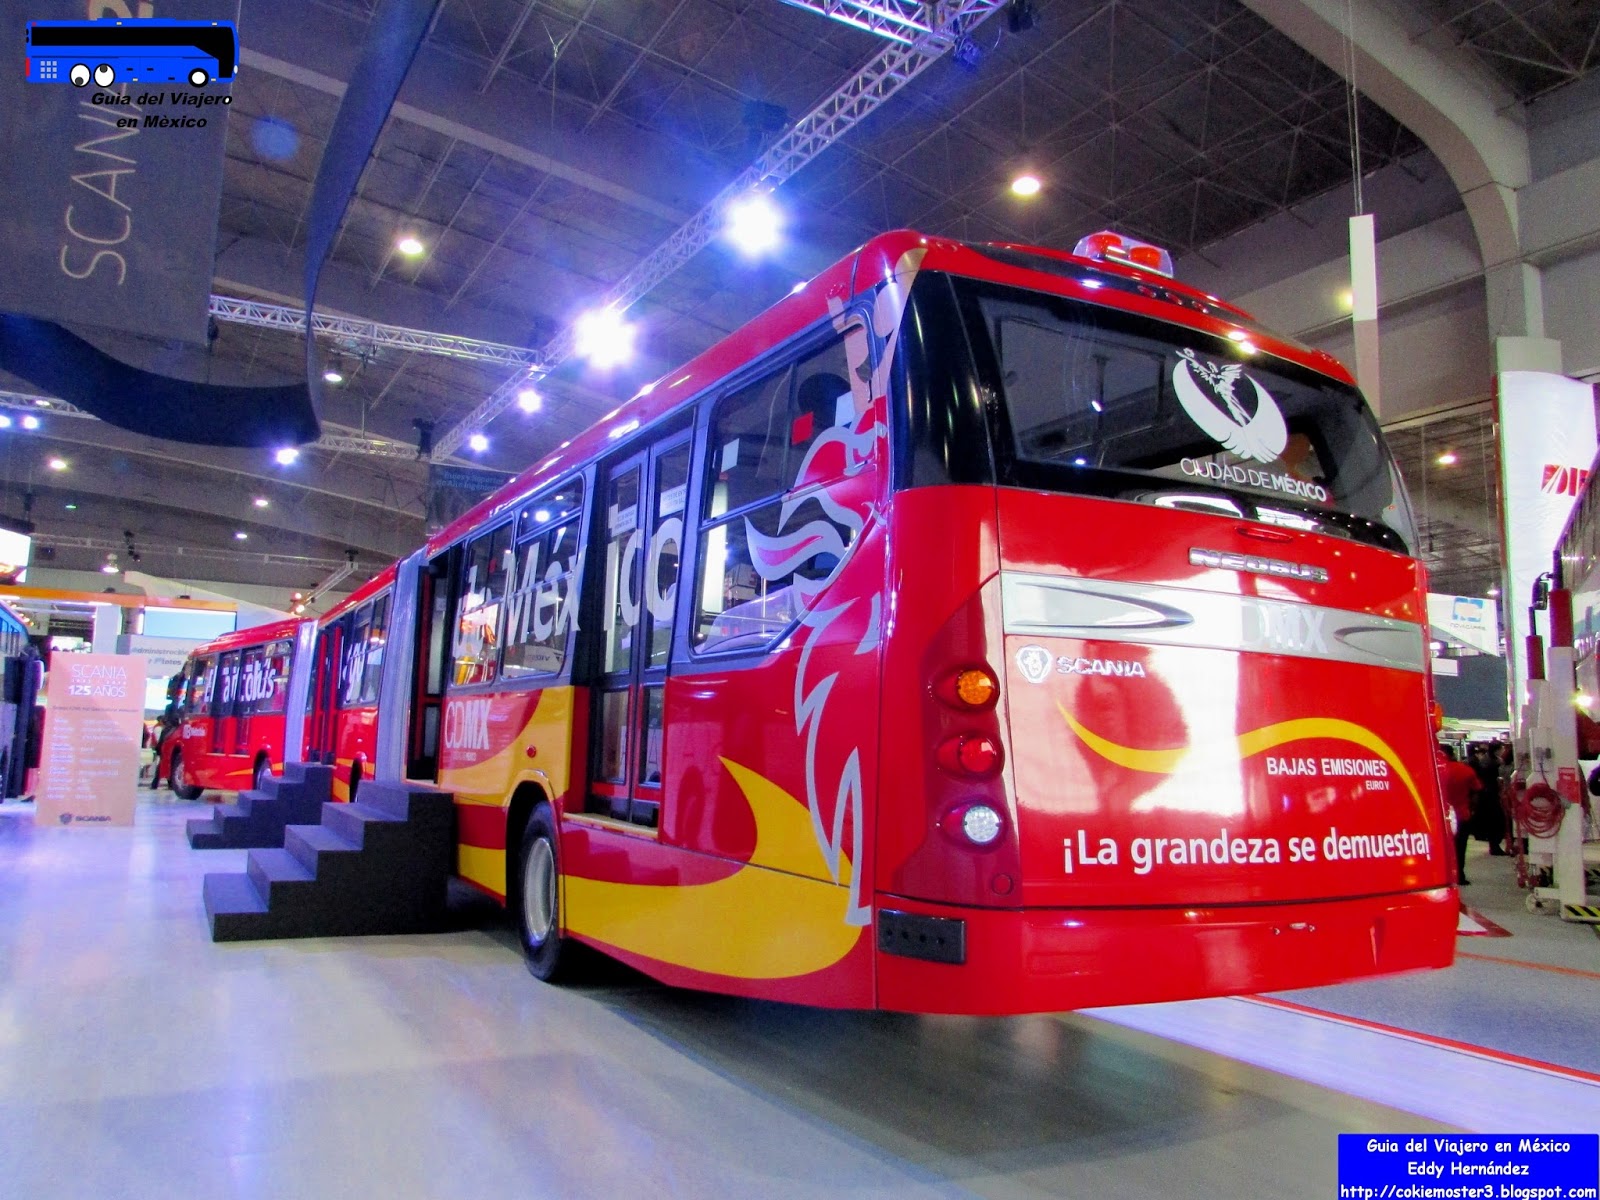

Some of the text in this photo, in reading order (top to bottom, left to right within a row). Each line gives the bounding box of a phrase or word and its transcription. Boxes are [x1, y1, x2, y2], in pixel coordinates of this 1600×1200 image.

[1180, 457, 1327, 502] CIUDAD DE MÉXICO
[1188, 547, 1329, 583] NEOBUS
[71, 664, 127, 679] SCANIA
[1056, 656, 1146, 679] SCANIA
[68, 684, 126, 698] 125 AÑOS
[444, 699, 493, 750] CDMX
[1267, 757, 1388, 777] BAJAS EMISIONES
[1365, 780, 1390, 791] EURO V
[1063, 829, 1118, 874] ¡La
[1130, 828, 1281, 875] grandeza
[1289, 835, 1316, 863] se
